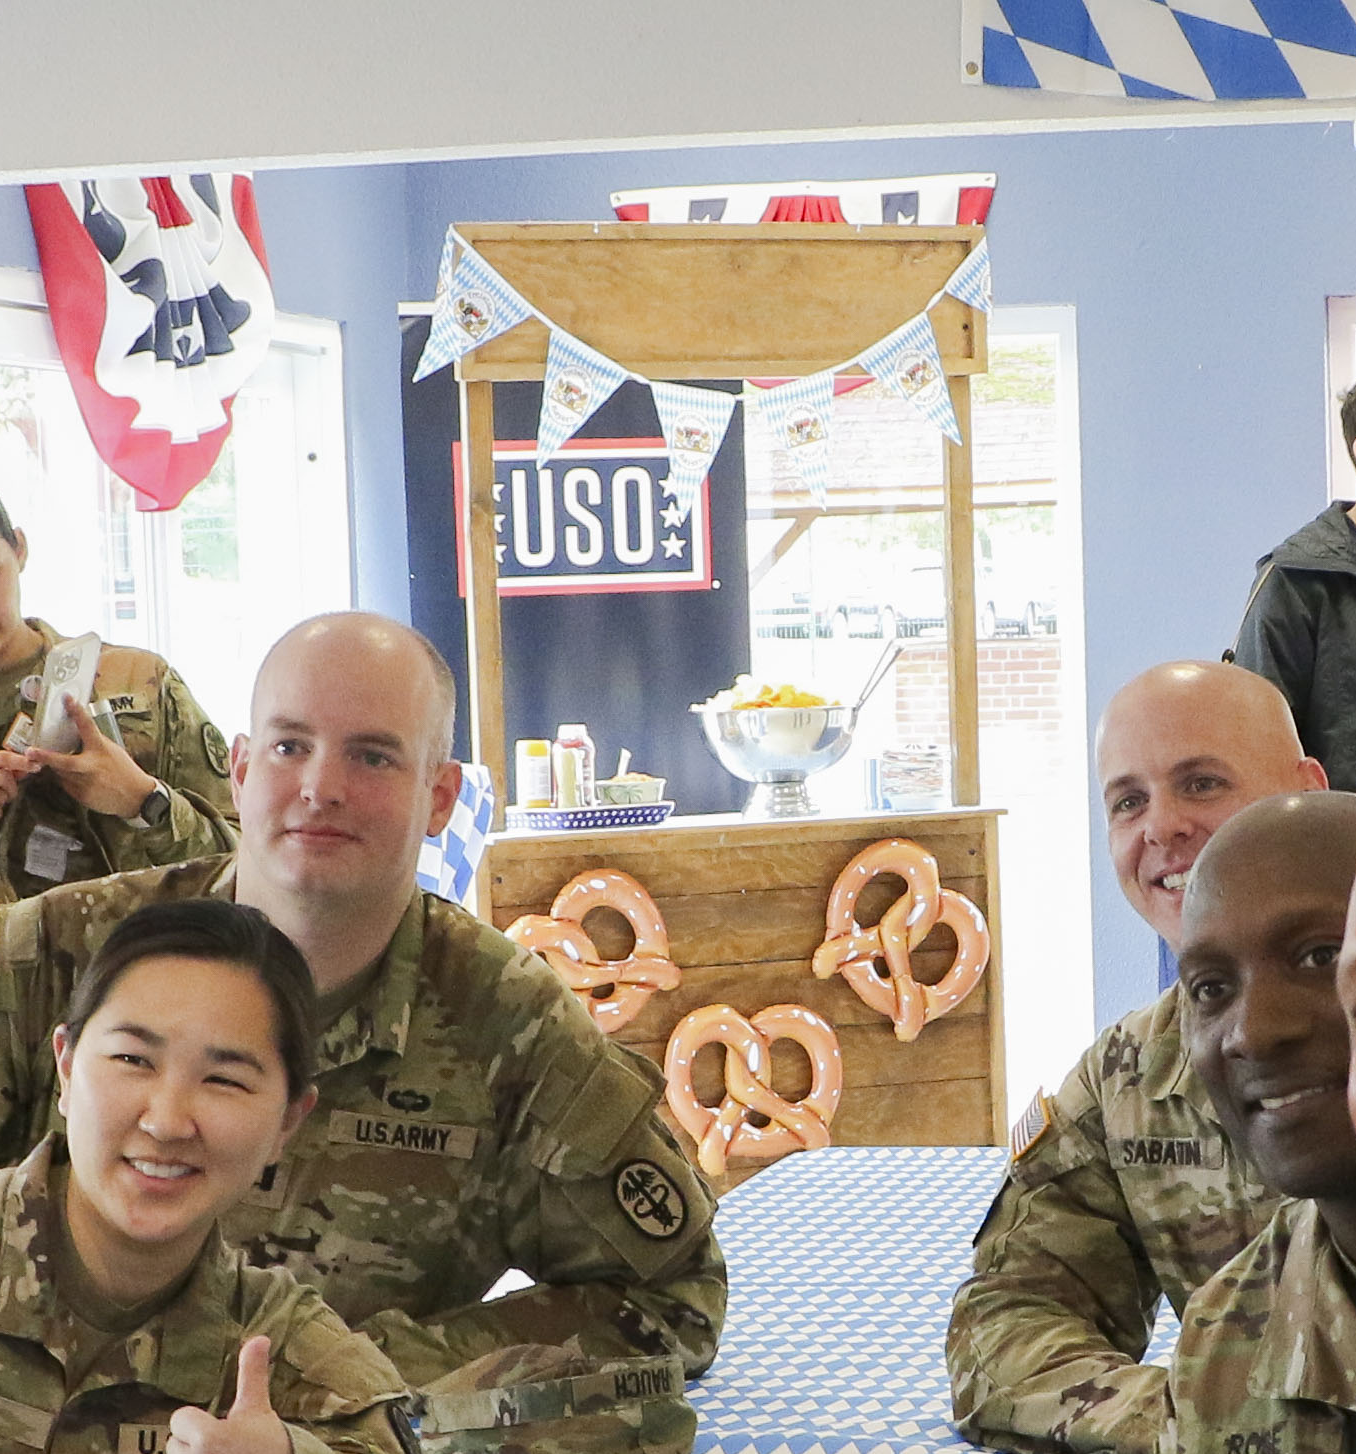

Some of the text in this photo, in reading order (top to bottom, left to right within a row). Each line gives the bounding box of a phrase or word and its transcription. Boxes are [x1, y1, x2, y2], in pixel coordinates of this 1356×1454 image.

[511, 466, 654, 568] USO
[392, 1124, 451, 1151] ARMY
[614, 1366, 671, 1400] RAUCH
